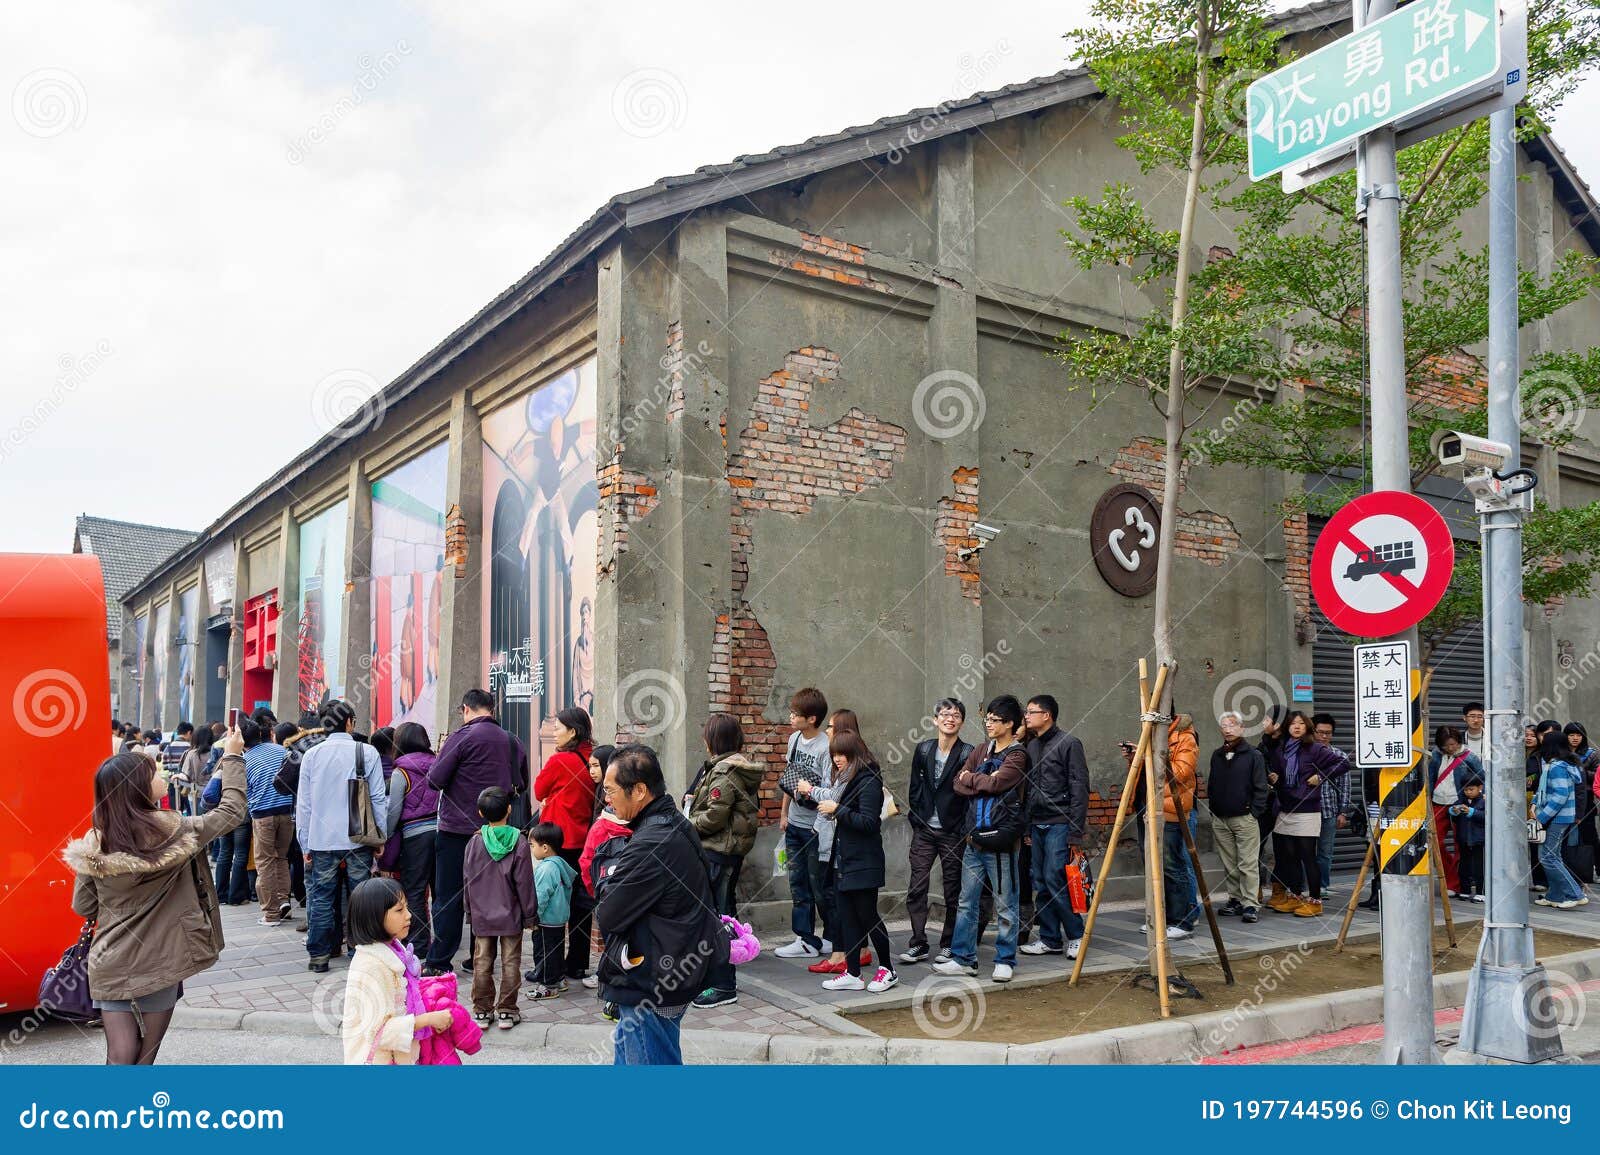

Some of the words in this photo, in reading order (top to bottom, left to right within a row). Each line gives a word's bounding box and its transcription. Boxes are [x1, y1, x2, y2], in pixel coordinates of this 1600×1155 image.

[1277, 81, 1391, 154] Dayong
[1405, 46, 1460, 96] Rd.
[1278, 0, 1459, 119] 大勇路
[1507, 71, 1519, 84] 98
[1108, 506, 1155, 571] C3
[1362, 650, 1382, 759] 禁止進入
[1383, 648, 1405, 760] 大型車輛
